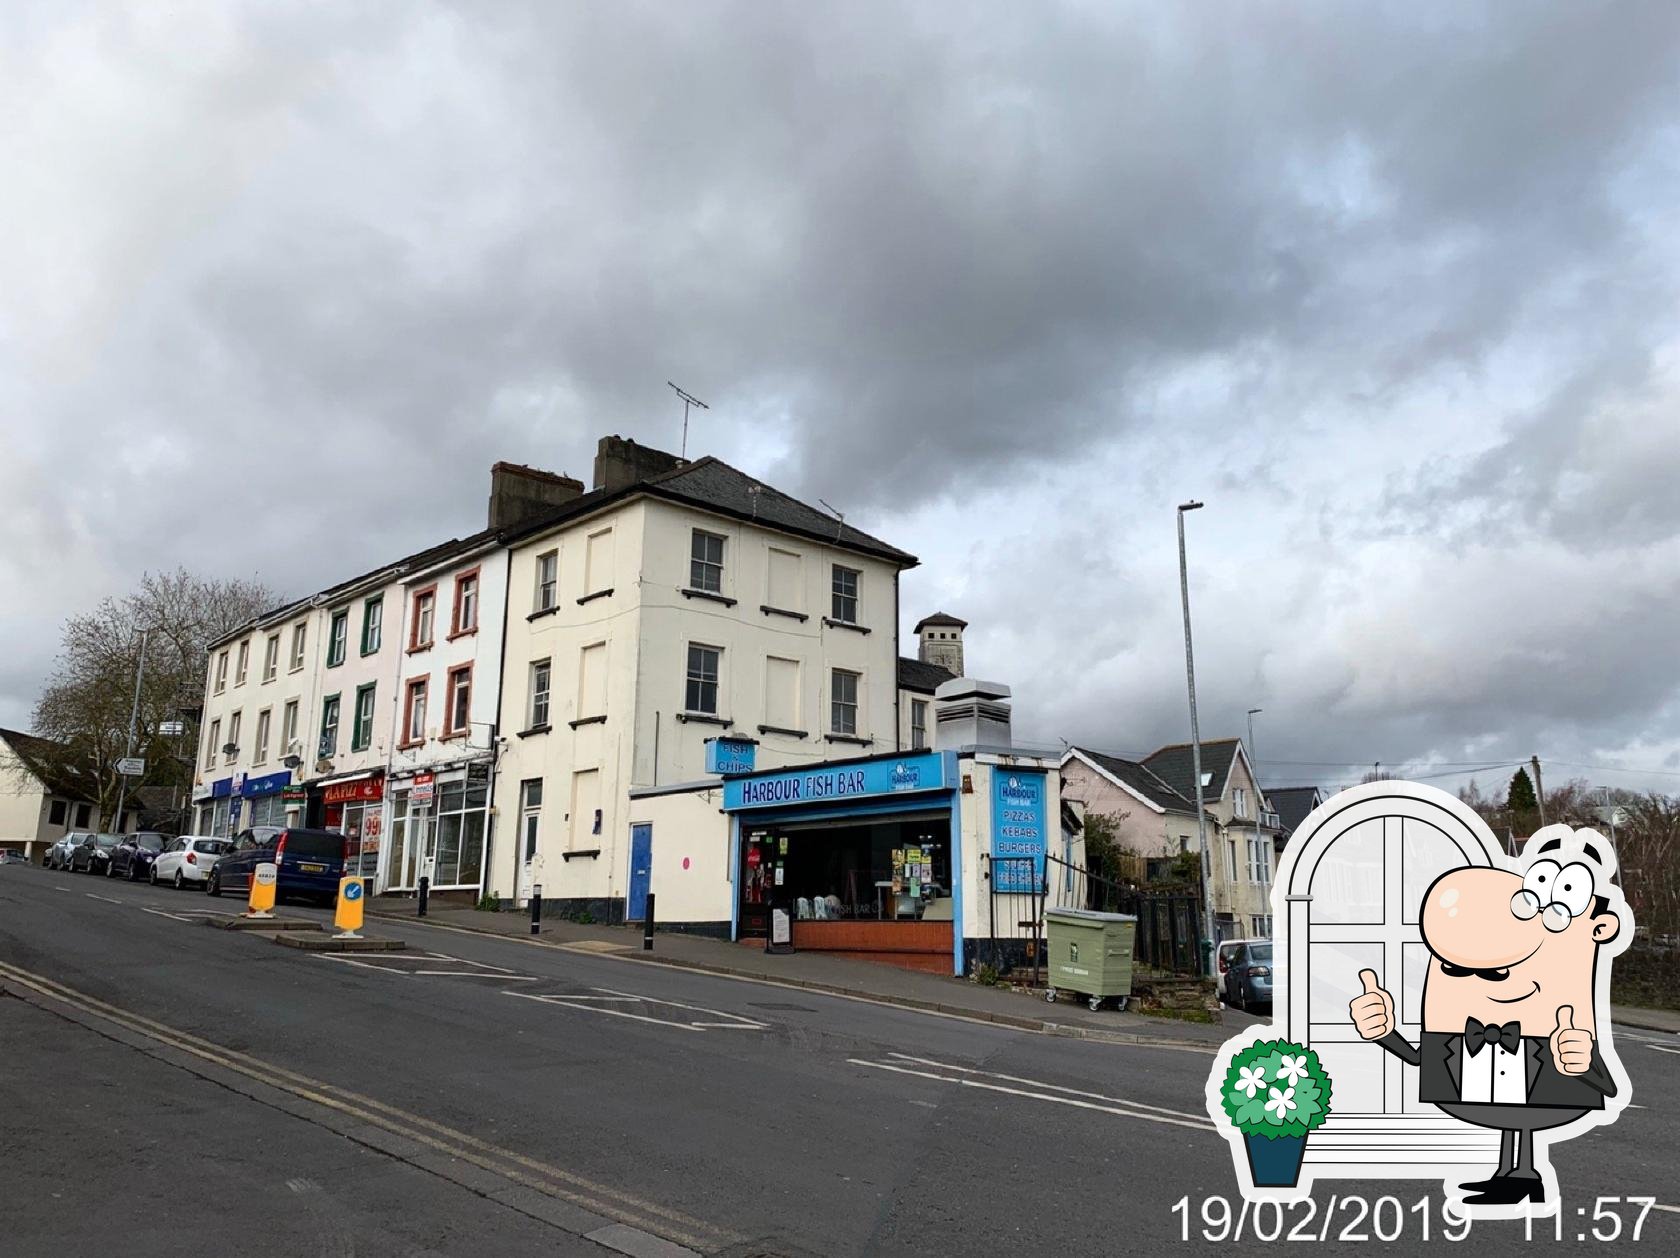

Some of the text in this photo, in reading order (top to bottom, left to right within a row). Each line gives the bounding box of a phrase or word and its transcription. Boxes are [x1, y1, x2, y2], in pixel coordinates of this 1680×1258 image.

[723, 744, 749, 754] FISH
[717, 761, 753, 774] CHIPS
[891, 772, 918, 785] HARBOUR
[742, 771, 865, 804] HARBOUR FISH BAR
[1002, 786, 1036, 799] HARBOUR
[1004, 811, 1035, 822] PIZZAS
[1002, 827, 1038, 838] KEBABS
[999, 842, 1041, 854] BURGERS
